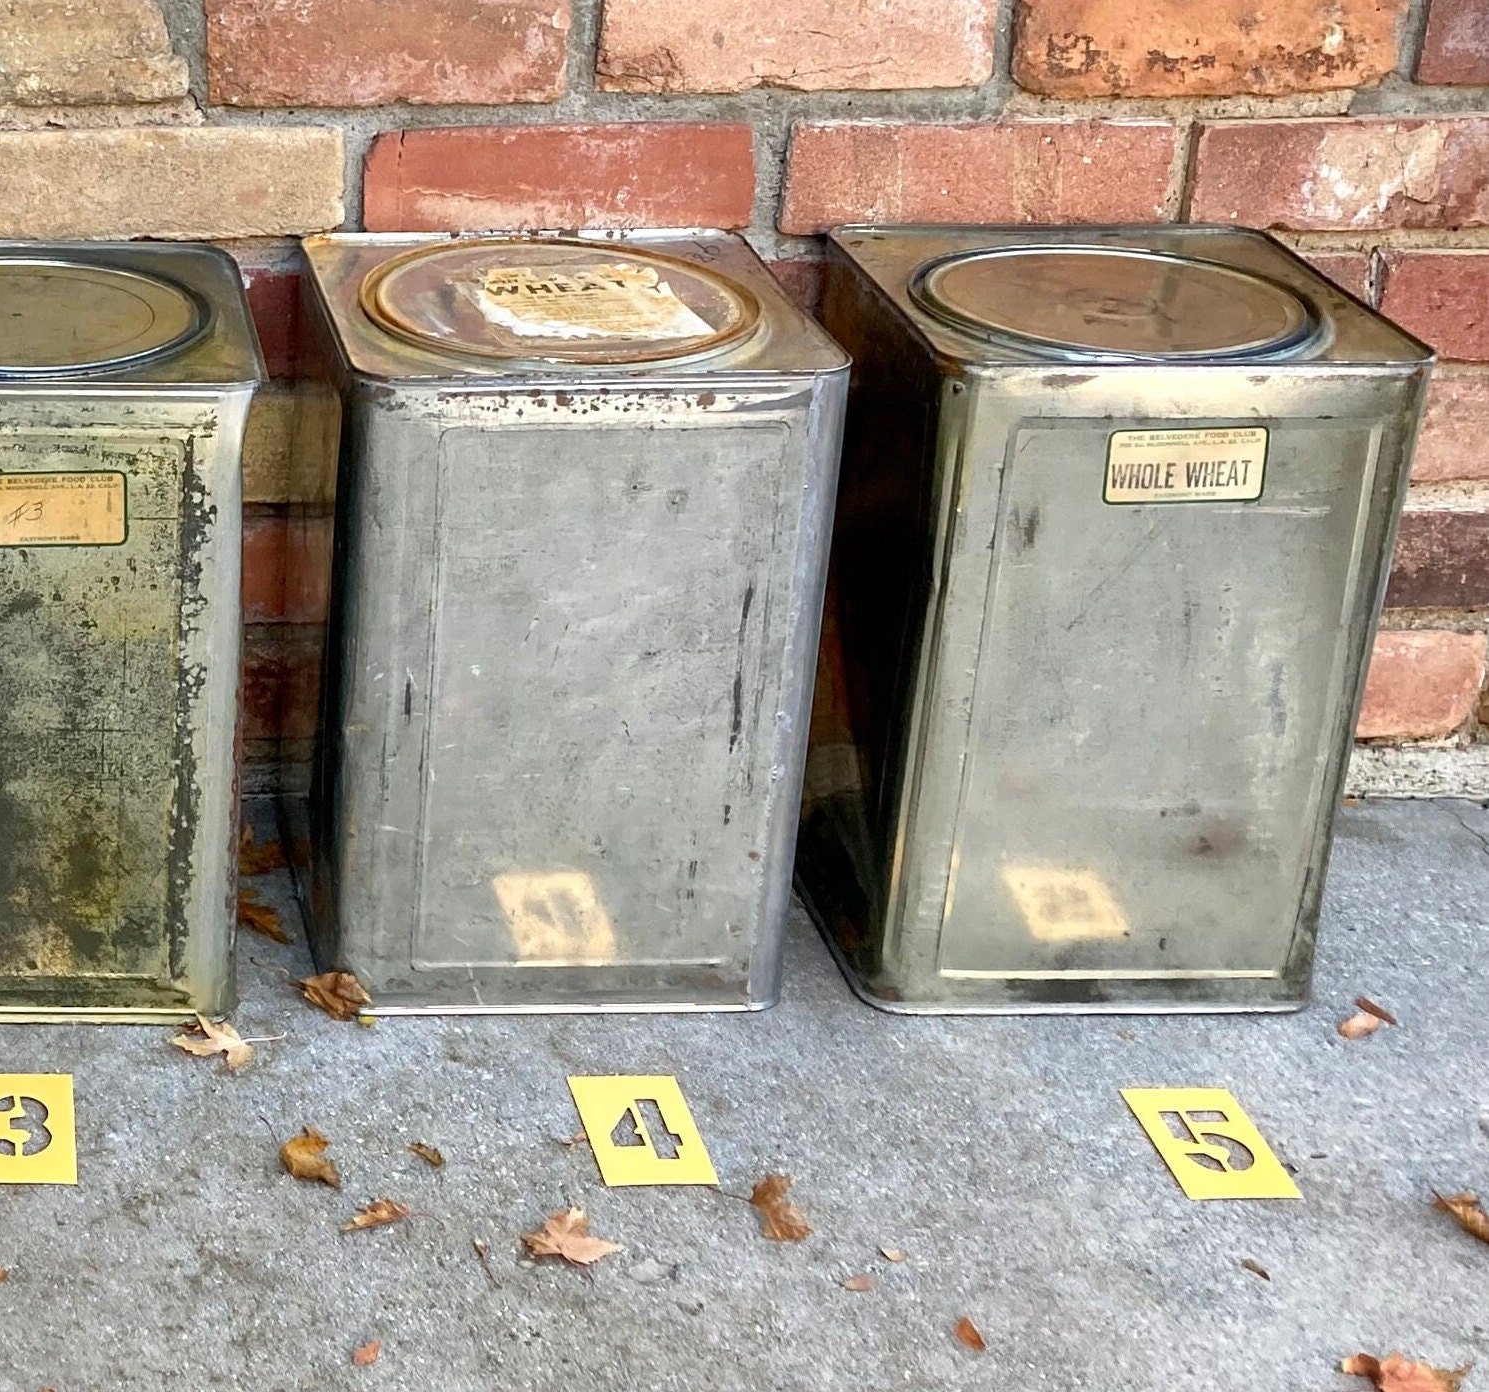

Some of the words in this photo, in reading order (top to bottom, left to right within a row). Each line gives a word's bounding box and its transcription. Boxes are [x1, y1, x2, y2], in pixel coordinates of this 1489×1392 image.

[1127, 434, 1145, 442] THE
[1149, 432, 1201, 441] BELVEDERE
[1205, 431, 1229, 439] FOOD
[1233, 430, 1256, 438] CLUB
[7, 476, 58, 485] BELVEDERE
[61, 475, 86, 483] FOOD
[90, 475, 114, 483] CLUB
[1111, 462, 1177, 490] WHOLE
[1185, 460, 1252, 488] WHEAT
[8, 499, 46, 528] #3
[610, 1099, 683, 1159] 4
[1158, 1111, 1254, 1172] 5
